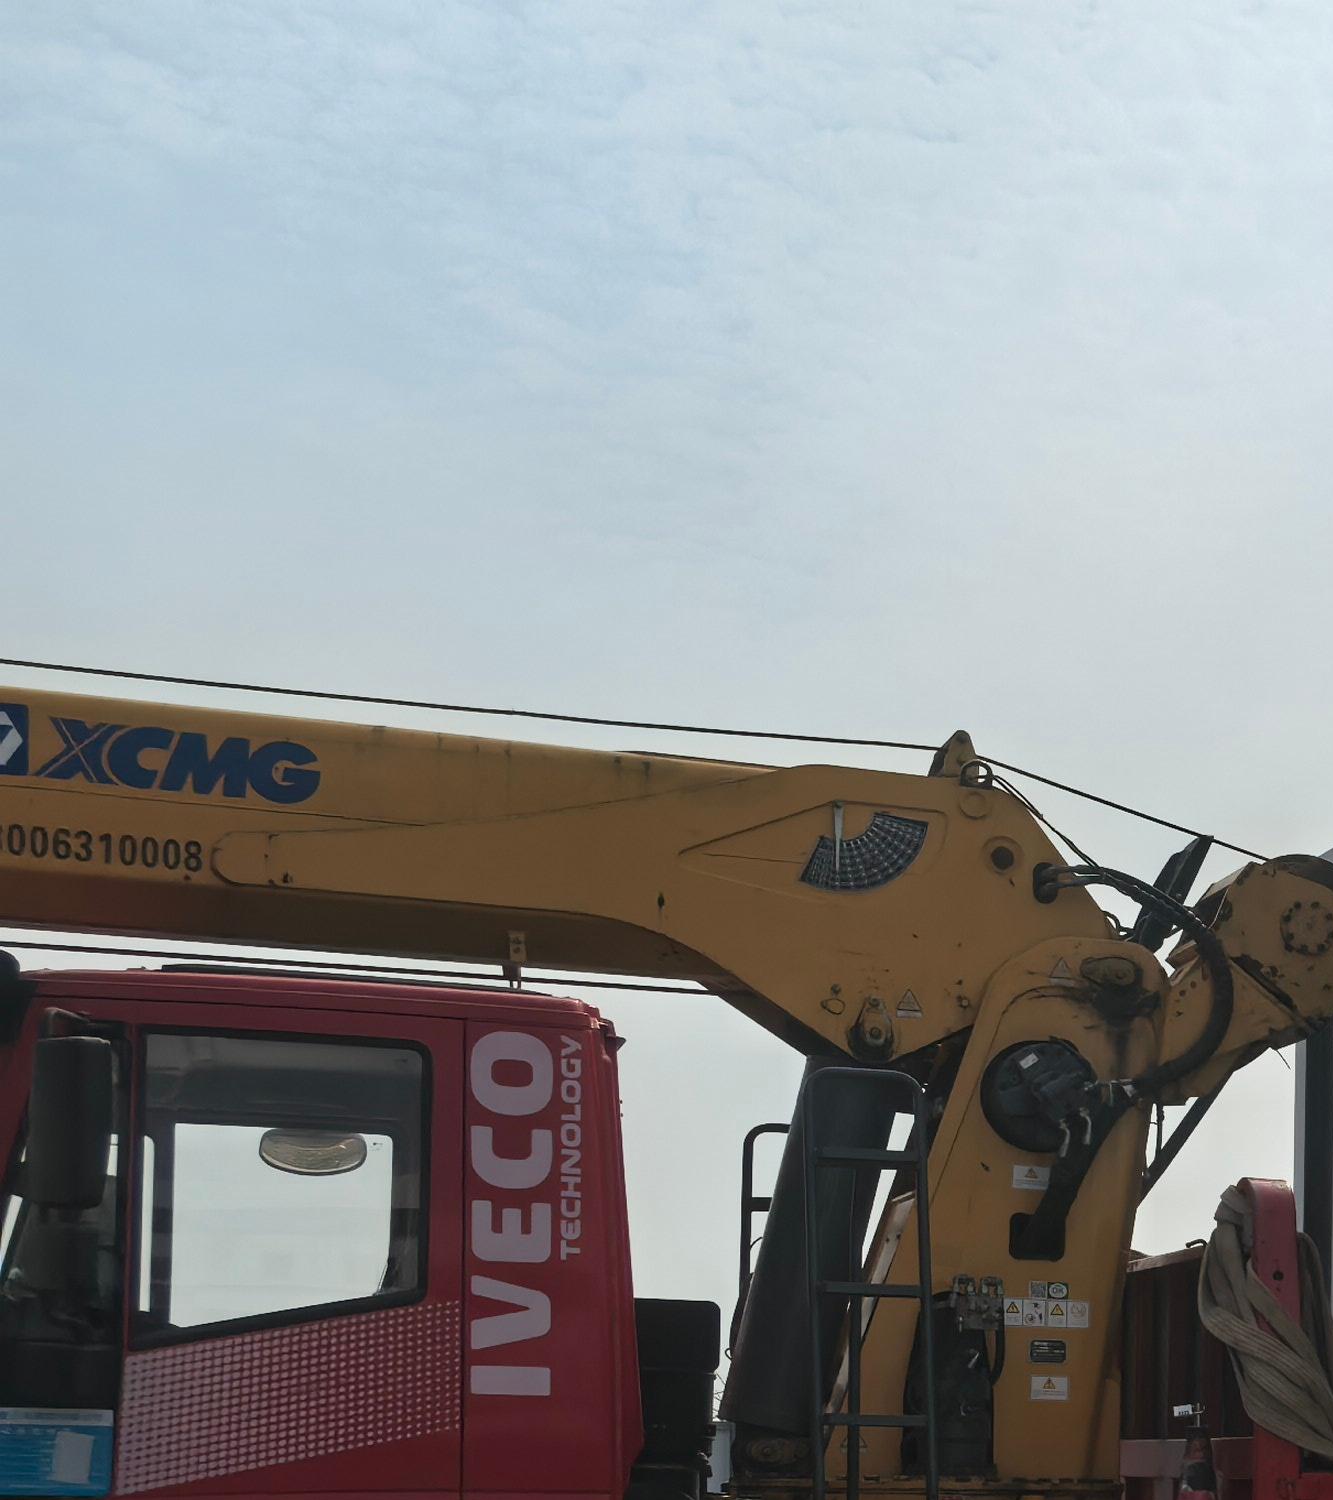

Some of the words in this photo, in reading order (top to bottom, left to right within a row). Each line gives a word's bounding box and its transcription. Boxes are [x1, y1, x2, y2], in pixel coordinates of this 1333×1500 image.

[35, 716, 321, 804] XCMG
[0, 823, 203, 872] 006310008
[470, 1031, 554, 1396] IVECO
[560, 1035, 582, 1260] TECHNOLOGY
